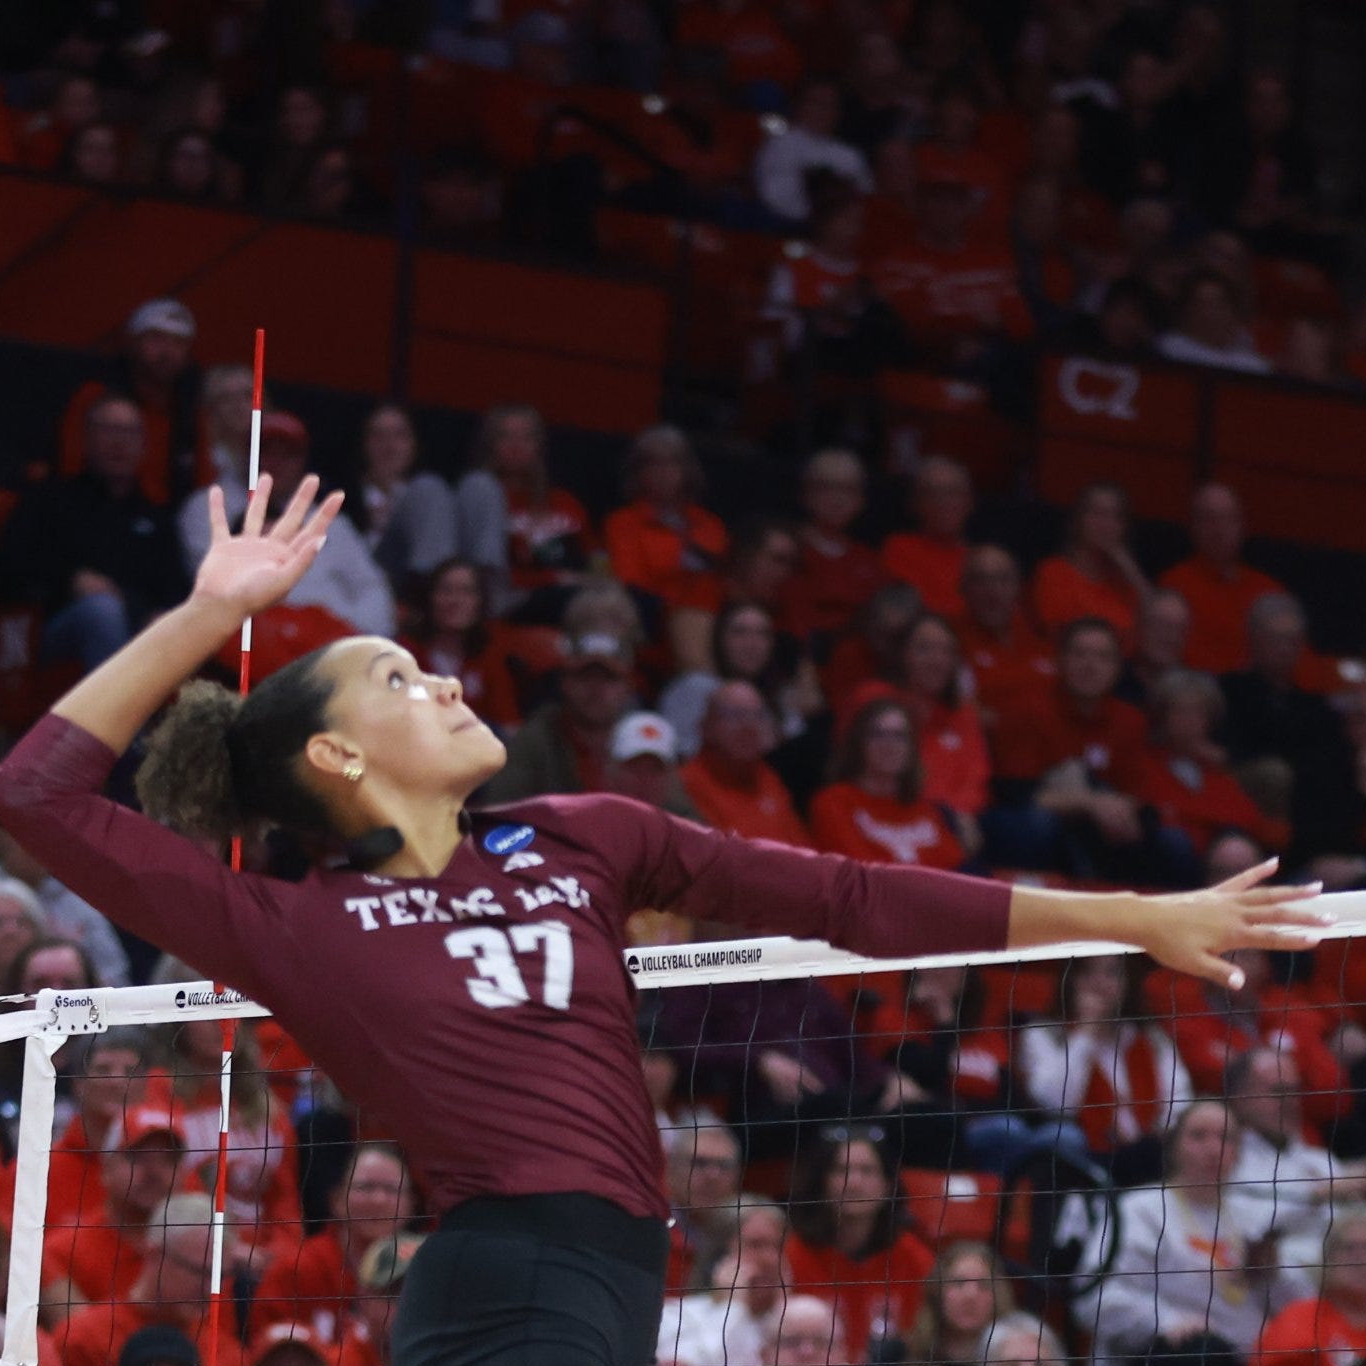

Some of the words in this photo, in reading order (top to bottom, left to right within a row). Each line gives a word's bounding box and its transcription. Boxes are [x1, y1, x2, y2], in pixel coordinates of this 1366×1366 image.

[444, 919, 574, 1010] 37
[641, 954, 693, 972] VOLLEYBALL
[694, 948, 762, 967] CHAMPIONSHIP
[63, 996, 93, 1007] Senoh
